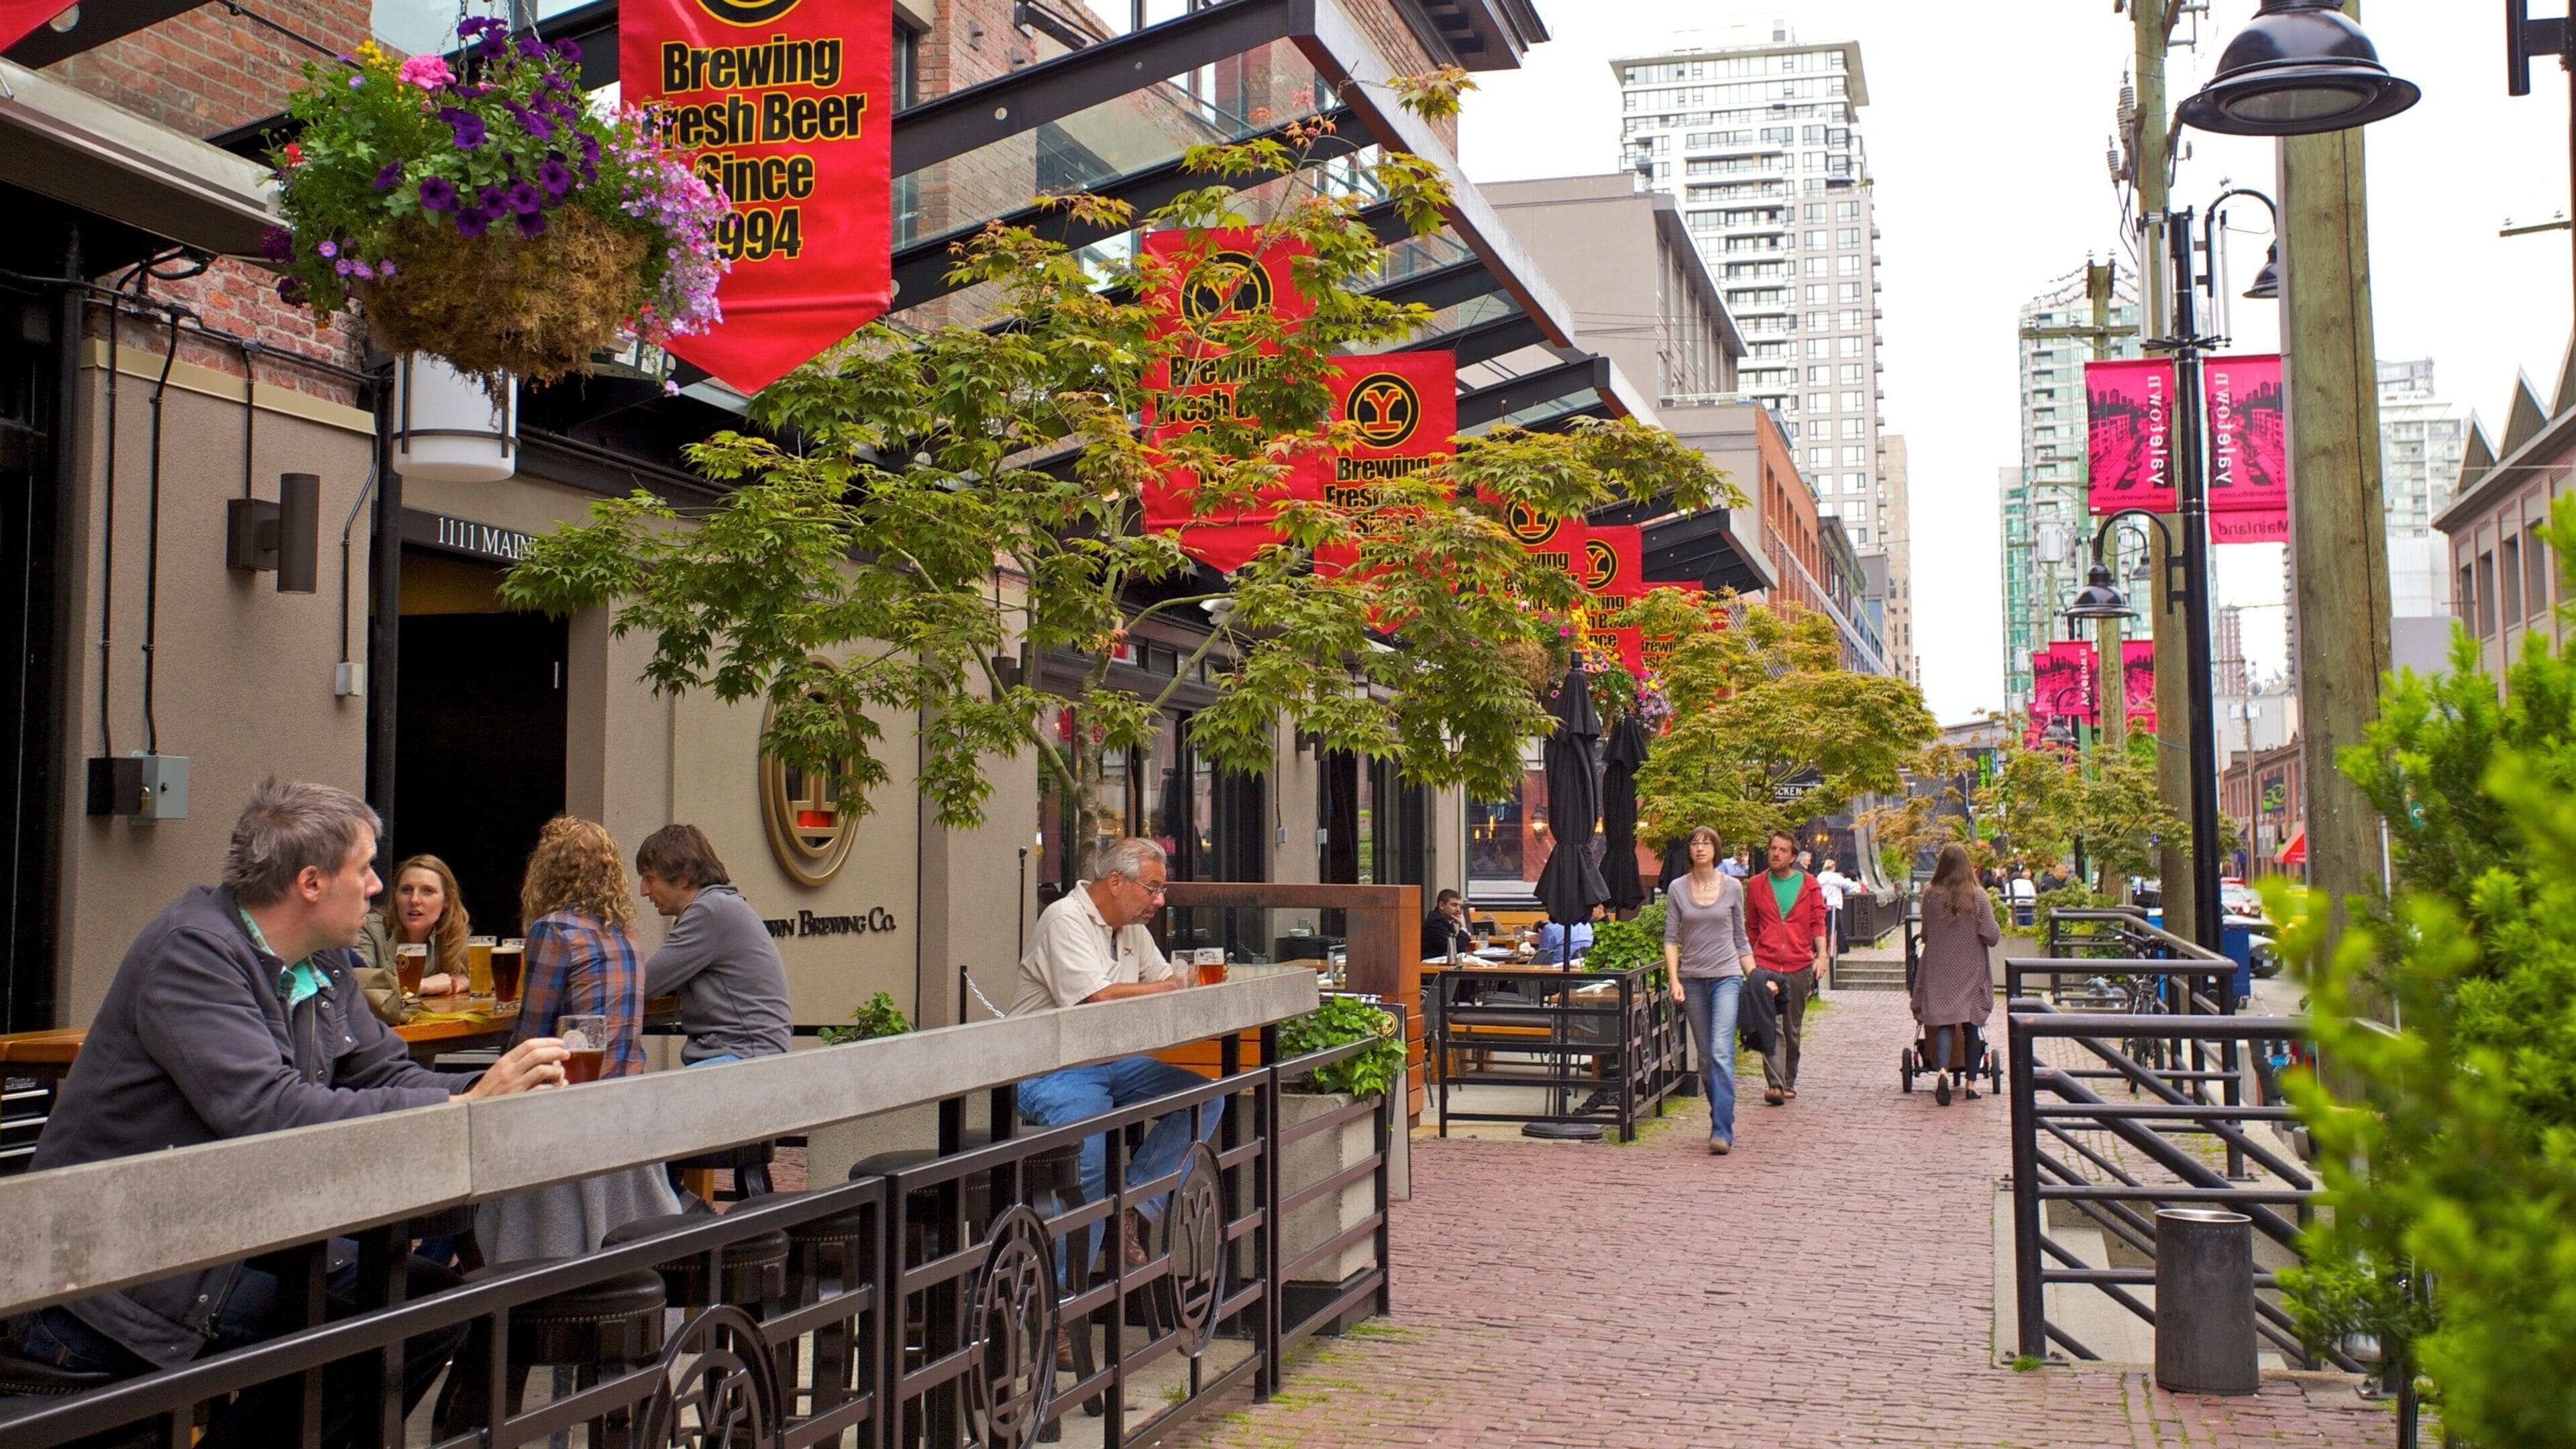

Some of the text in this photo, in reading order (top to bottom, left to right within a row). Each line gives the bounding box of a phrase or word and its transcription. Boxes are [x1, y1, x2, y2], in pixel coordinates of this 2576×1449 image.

[661, 34, 843, 94] Brewing
[760, 92, 867, 144] Beer
[694, 151, 815, 203] Since
[707, 205, 804, 262] 994
[437, 517, 476, 551] 1111
